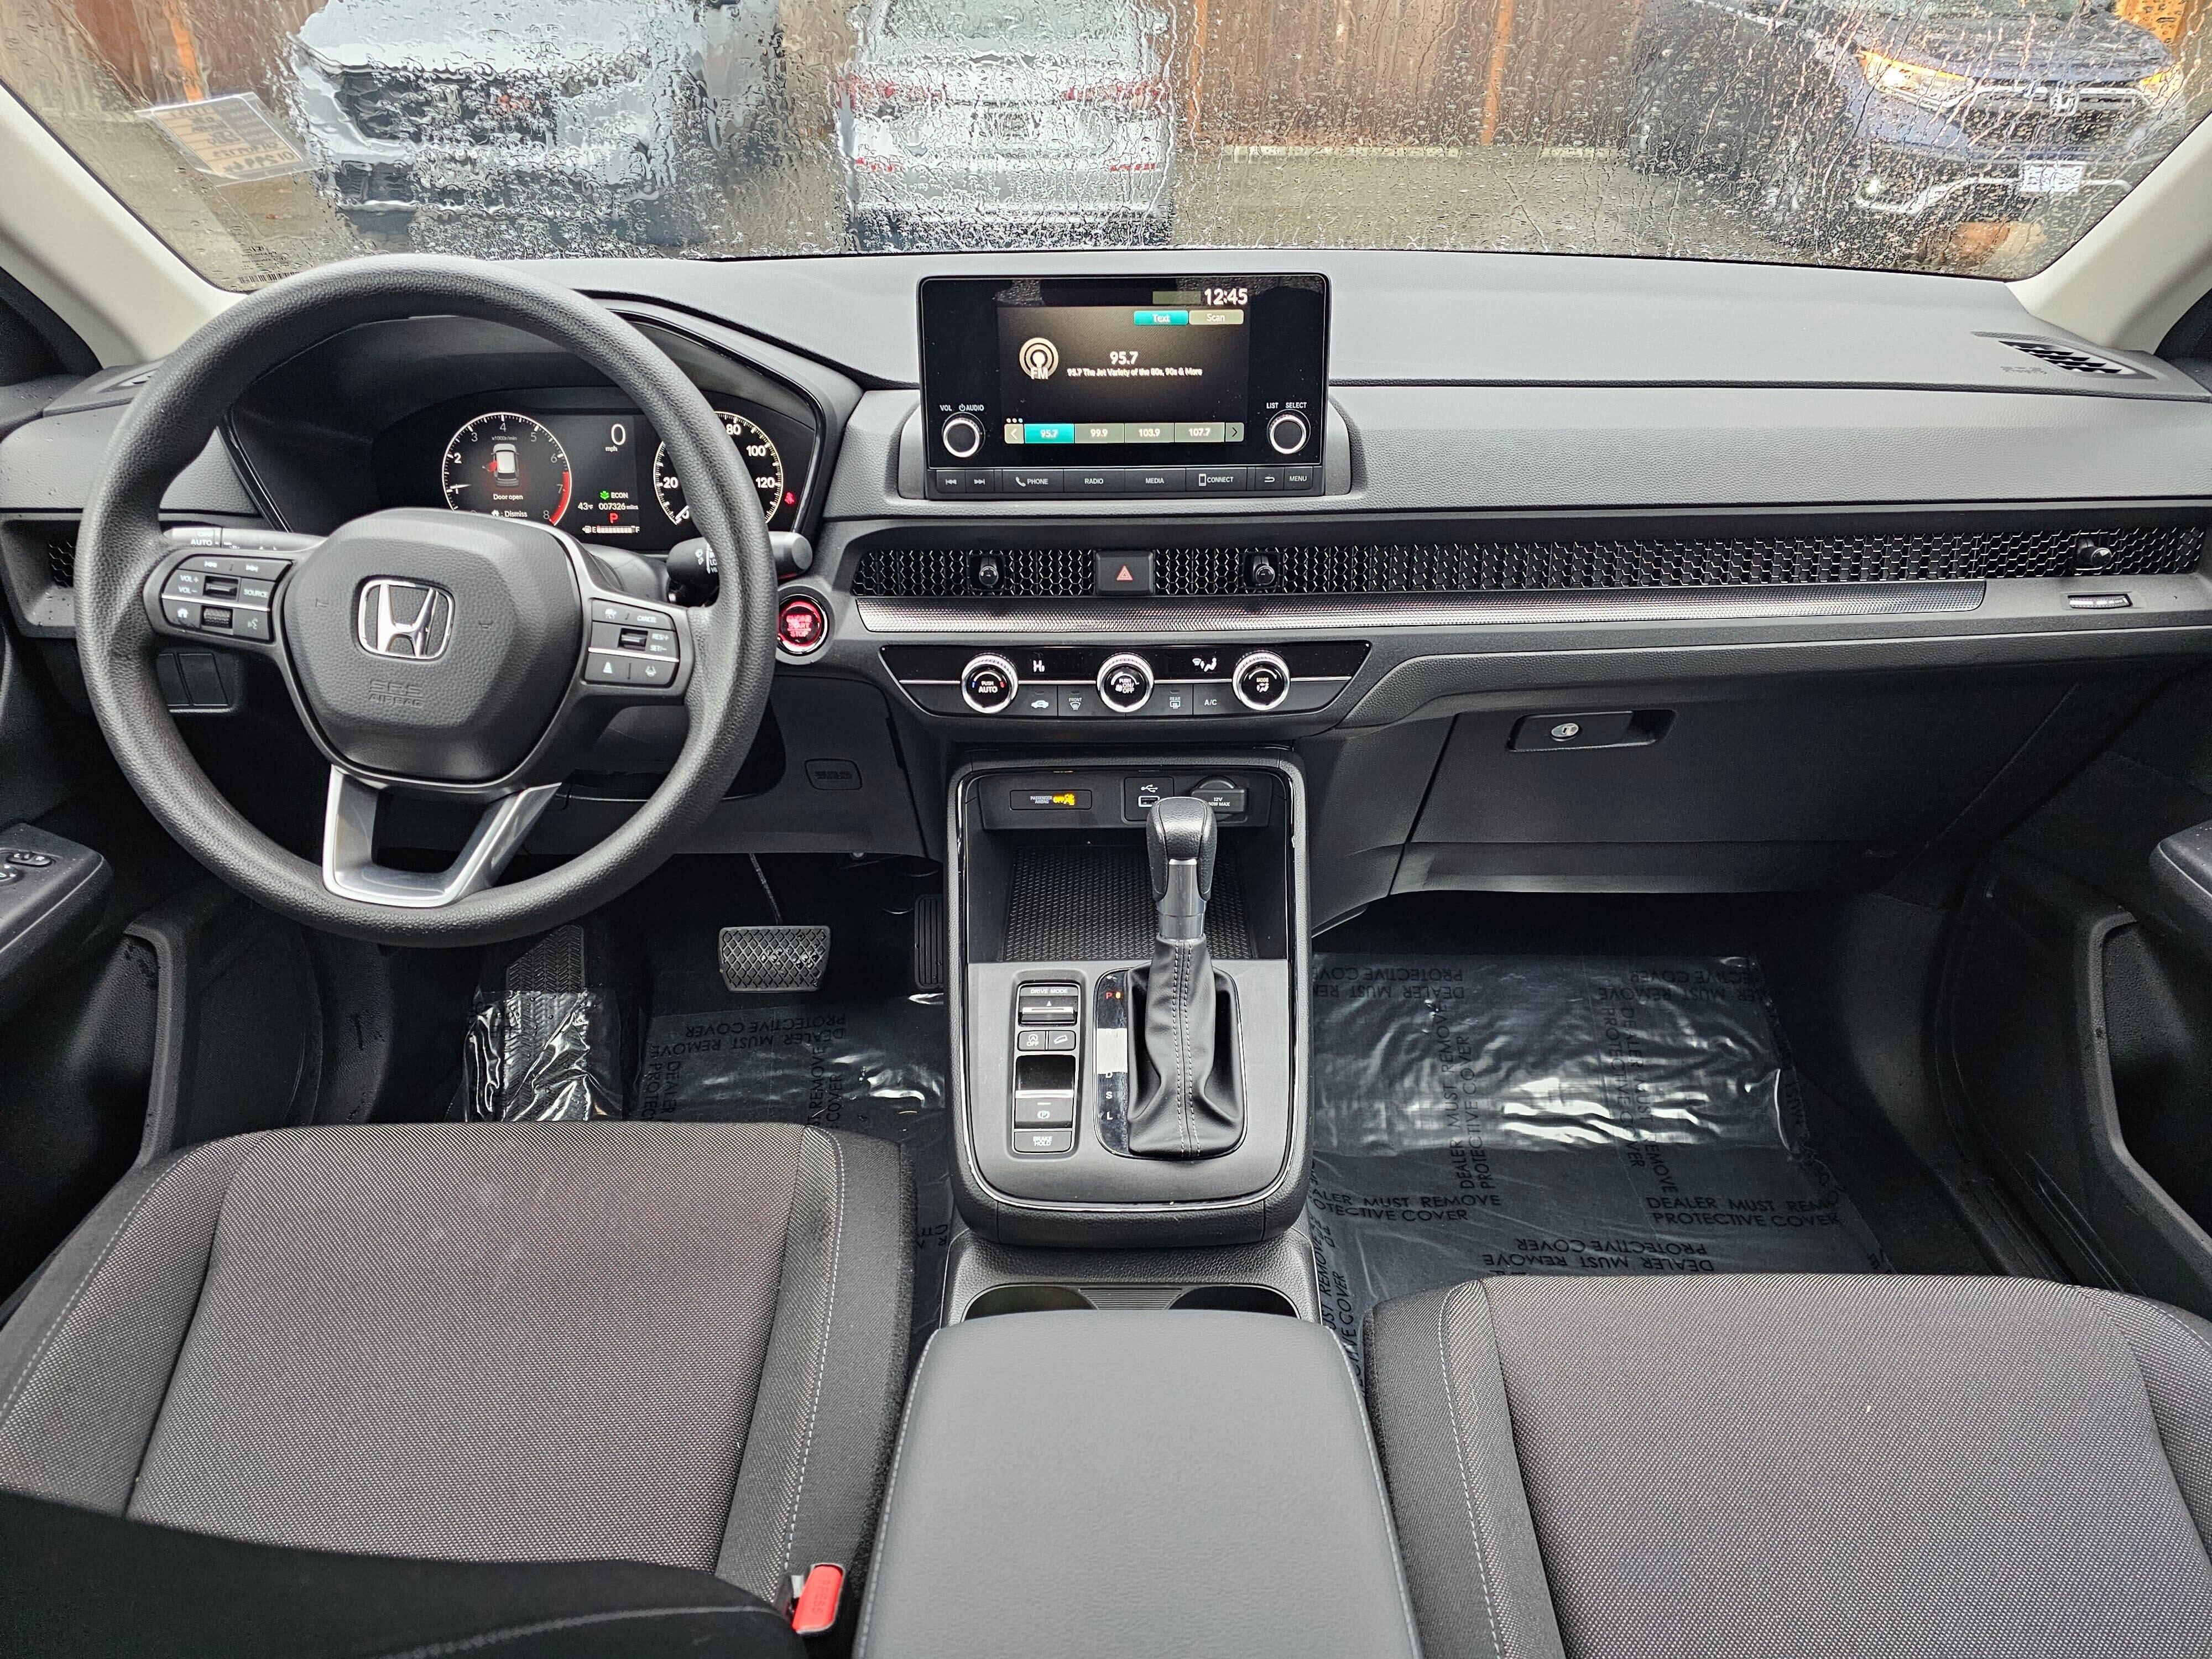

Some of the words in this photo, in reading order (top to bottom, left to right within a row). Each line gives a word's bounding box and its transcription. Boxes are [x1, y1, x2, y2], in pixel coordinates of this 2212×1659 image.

[1204, 288, 1248, 305] 12:45
[1152, 313, 1170, 323] Text
[1206, 313, 1225, 322] Scan
[1109, 351, 1138, 365] 95.7
[1030, 367, 1048, 379] FM
[1067, 368, 1082, 376] 95.7
[1185, 368, 1203, 376] More
[499, 424, 506, 432] 4
[611, 424, 626, 446] 0
[726, 424, 741, 435] 80
[1040, 429, 1058, 438] 95.7
[1090, 429, 1108, 437] 99.9
[1139, 428, 1161, 437] 103.9
[1188, 427, 1211, 437] 107.7
[471, 432, 478, 442] 3
[530, 432, 537, 442] 5
[746, 445, 766, 456] 100
[453, 452, 462, 464] 2
[556, 484, 563, 494] 7
[663, 477, 679, 489] 20
[755, 477, 775, 488] 120
[598, 502, 626, 510] 007326
[542, 510, 550, 519] 8
[609, 513, 618, 524] P
[243, 588, 269, 599] SOURCE
[637, 615, 657, 623] CANCEL
[1363, 968, 1463, 982] PROTECTIVE
[1350, 984, 1392, 998] MUST
[1402, 985, 1465, 1000] DEALER
[685, 1021, 744, 1038] COVER
[749, 1014, 846, 1033] PROTECTIVE
[731, 1035, 774, 1051] MUST
[783, 1026, 845, 1046] DEALER
[1436, 1004, 1455, 1073] REMOVE
[1620, 1007, 1644, 1067] DEALER
[1602, 1007, 1631, 1106] PROTECTIVE
[1455, 1035, 1478, 1095] COVER
[808, 1047, 826, 1112] REMOVE
[826, 1073, 845, 1123] COVER
[1105, 1091, 1113, 1099] S
[1443, 1083, 1462, 1129] MUST
[1107, 1112, 1113, 1120] L
[1465, 1100, 1496, 1190] PROTECTIVE
[1449, 1139, 1475, 1190] DEALER
[1363, 1196, 1411, 1208] MUST
[1420, 1194, 1502, 1208] REMOVE
[1646, 1196, 1718, 1210] DEALER
[1728, 1198, 1775, 1212] MUST
[1401, 1208, 1469, 1222] COVER
[1653, 1212, 1768, 1227] PROTECTIVE
[1771, 1212, 1842, 1227] COVER
[1516, 1238, 1587, 1254] COVER
[1590, 1239, 1708, 1256] PROTECTIVE
[1483, 1253, 1568, 1269] REMOVE
[1579, 1255, 1630, 1270] MUST
[1641, 1256, 1714, 1272] DEALER
[1331, 1270, 1355, 1325] COVER
